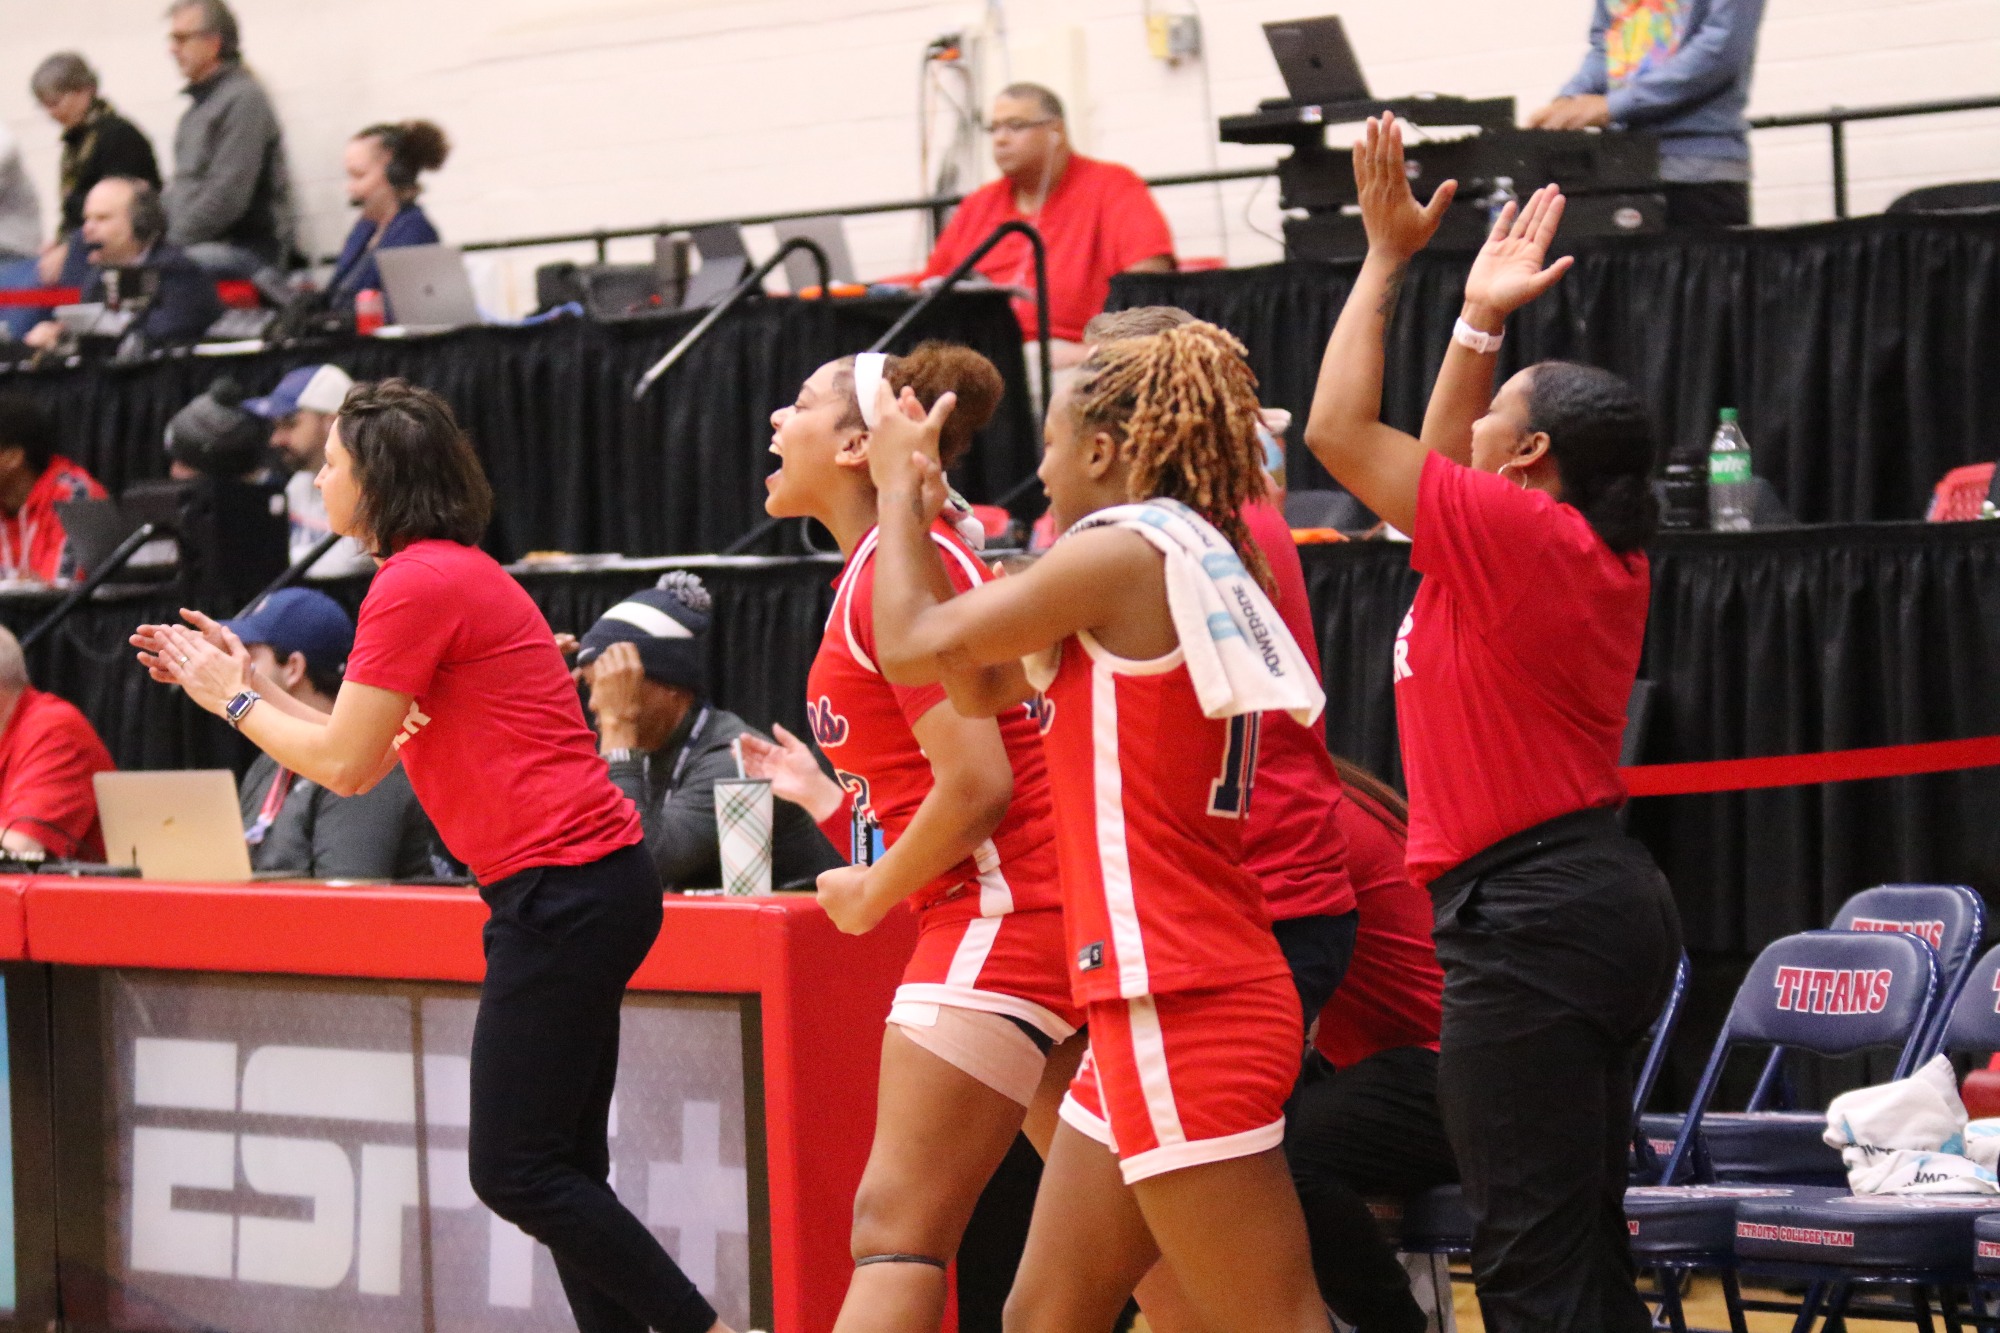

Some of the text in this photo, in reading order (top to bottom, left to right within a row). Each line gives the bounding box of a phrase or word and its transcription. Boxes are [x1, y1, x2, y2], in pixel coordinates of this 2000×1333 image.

[1232, 584, 1285, 679] POWERADE
[857, 813, 868, 865] ERAD
[1775, 965, 1893, 1015] TITANS
[131, 1037, 749, 1310] ESP+
[1780, 1226, 1822, 1245] COLLEGE
[1822, 1230, 1855, 1248] TEAM
